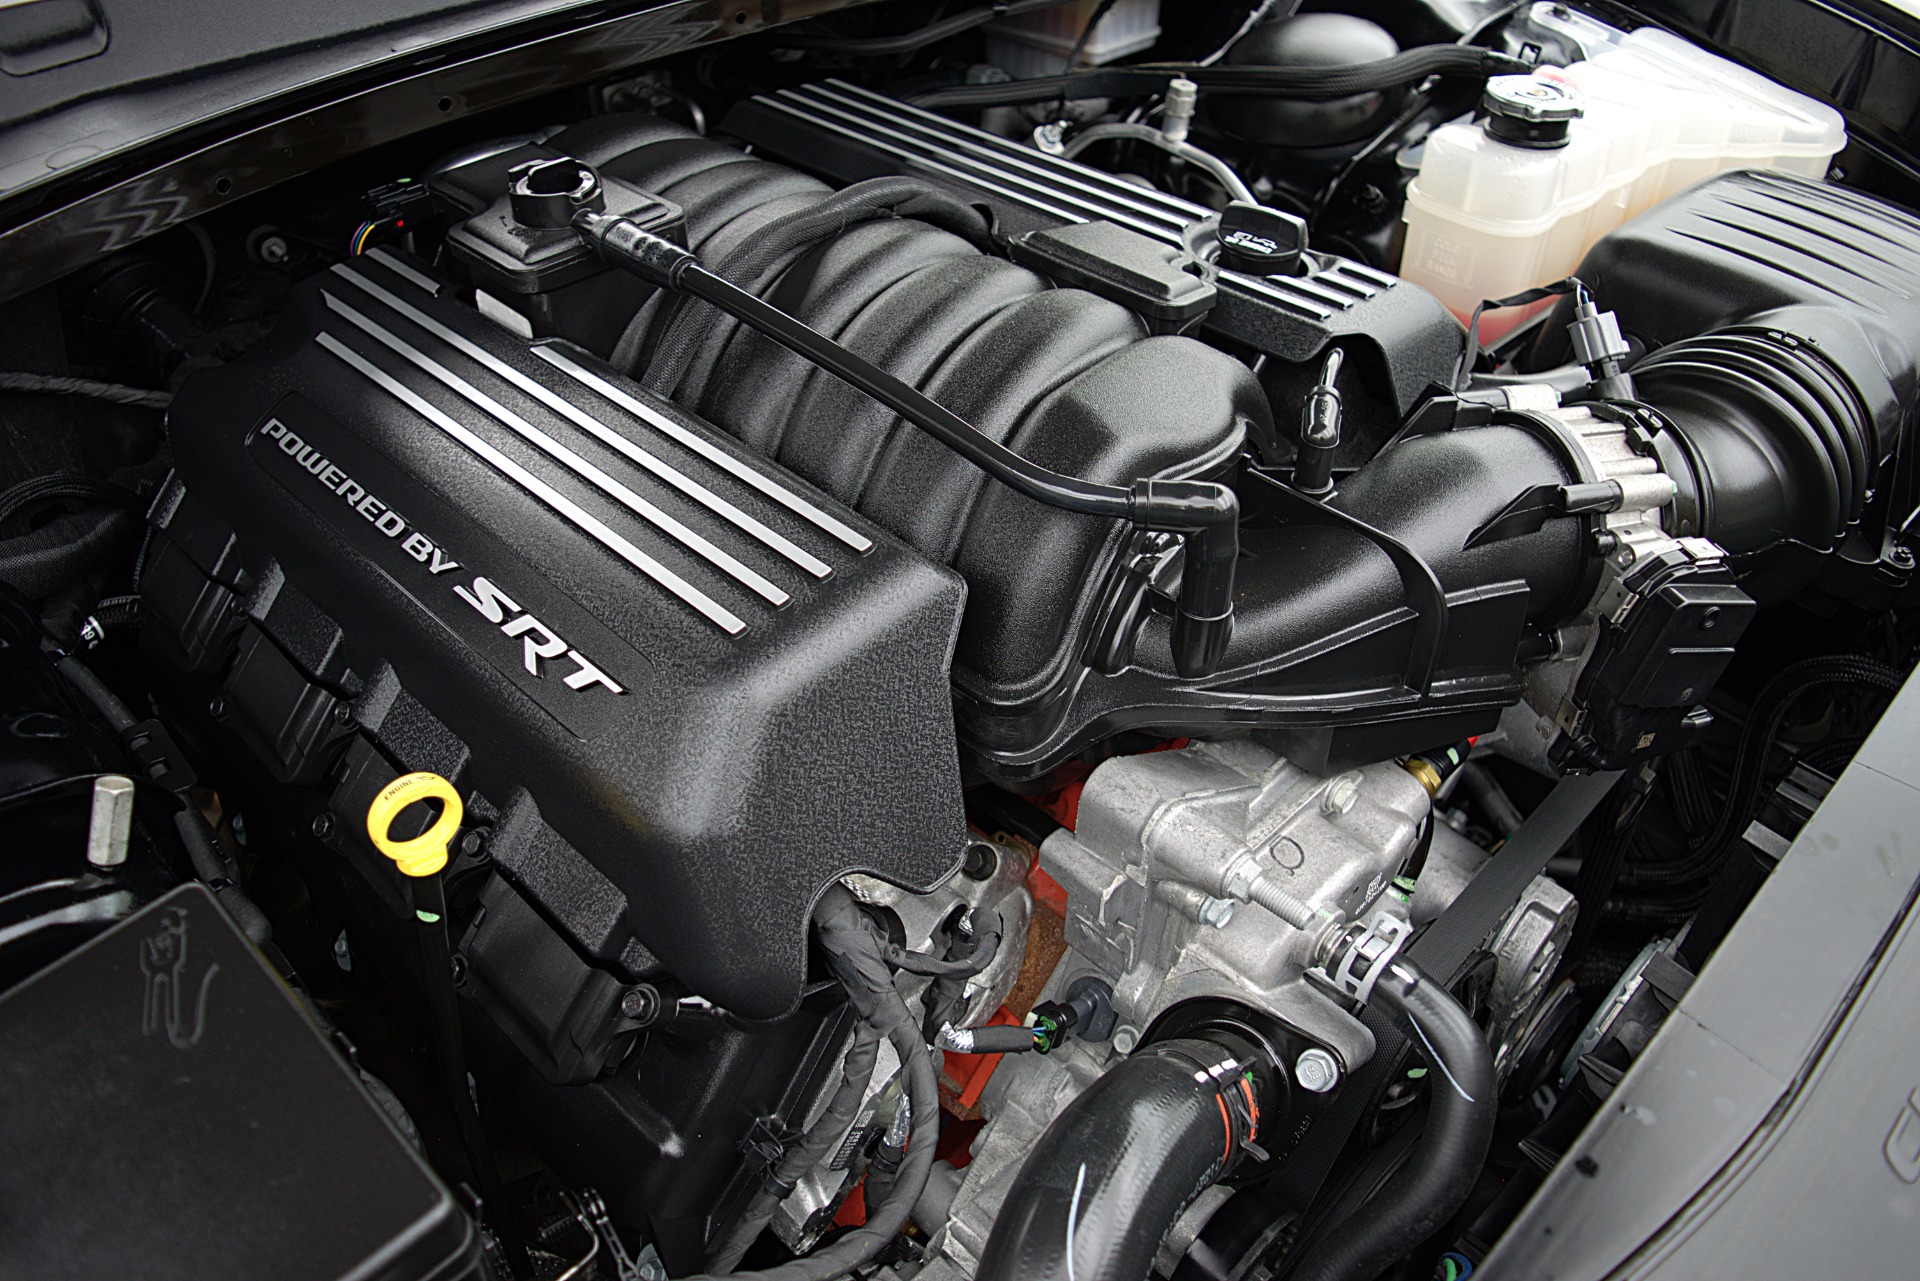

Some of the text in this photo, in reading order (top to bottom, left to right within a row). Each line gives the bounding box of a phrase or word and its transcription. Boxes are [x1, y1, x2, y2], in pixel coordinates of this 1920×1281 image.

[261, 418, 459, 574] POWERED BY
[453, 576, 625, 695] SRT
